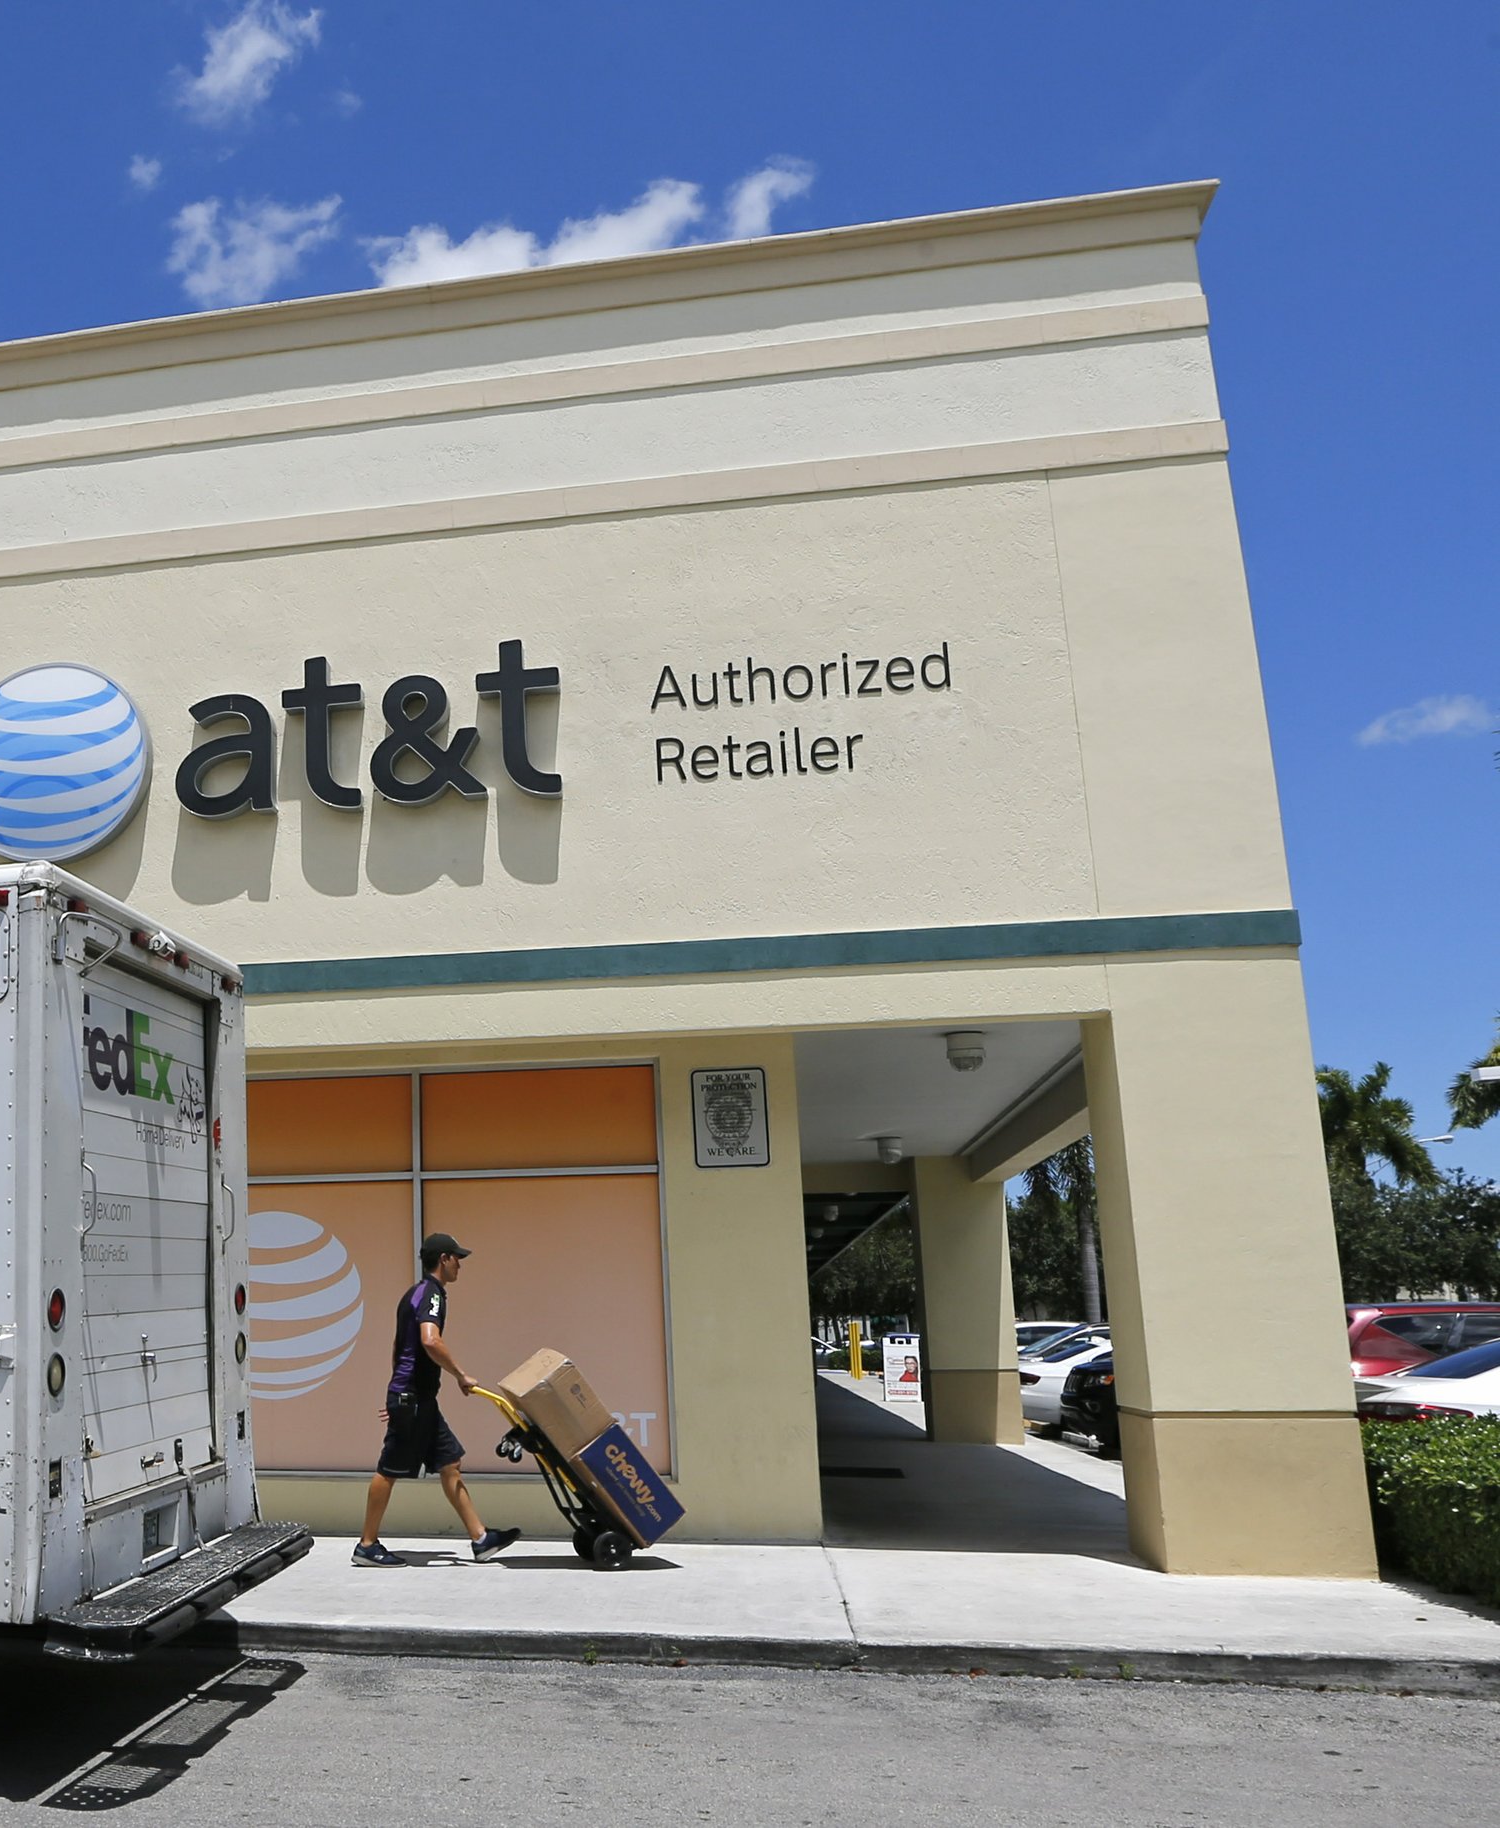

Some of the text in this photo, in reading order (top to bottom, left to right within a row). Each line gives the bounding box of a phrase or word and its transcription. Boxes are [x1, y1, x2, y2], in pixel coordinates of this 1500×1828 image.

[650, 641, 951, 713] Authorized
[175, 639, 563, 820] at&t
[655, 727, 863, 784] Retailer
[701, 1082, 757, 1092] PROTECTION
[706, 1073, 751, 1083] FOR YOUR
[136, 1122, 186, 1152] Home Delivery
[707, 1147, 756, 1157] WE CARE
